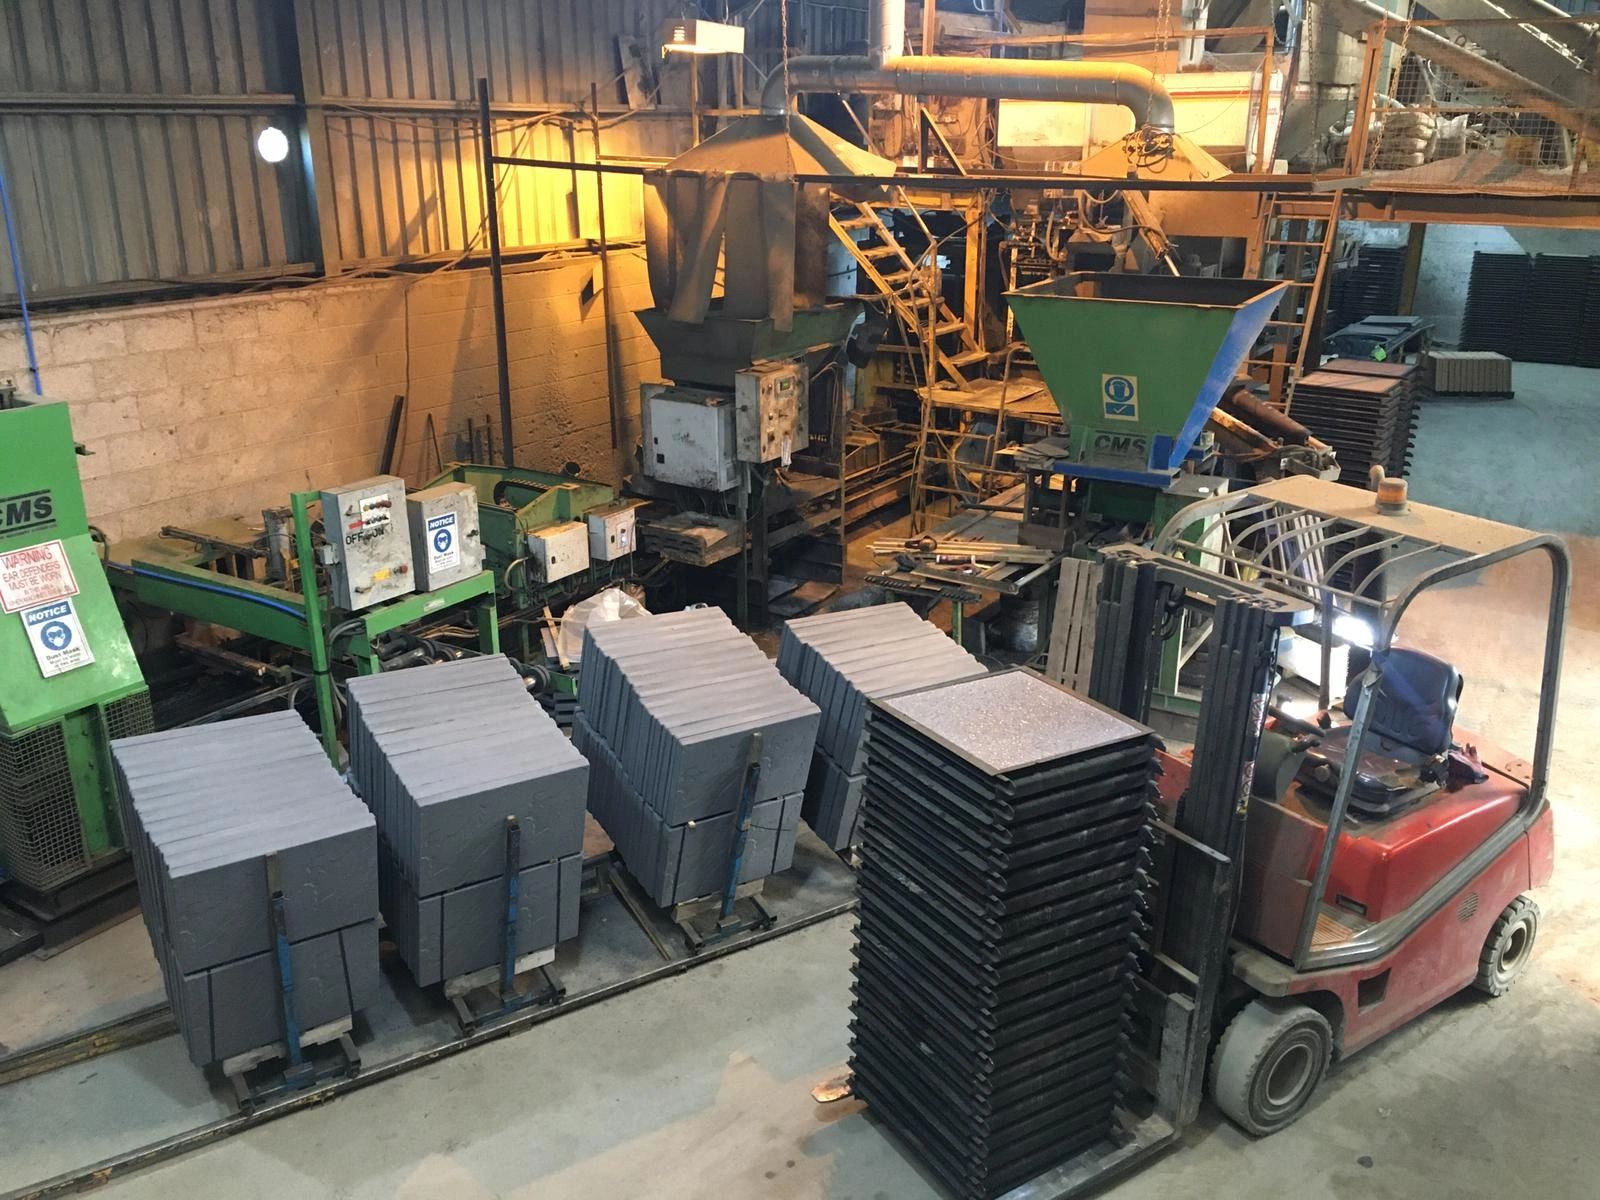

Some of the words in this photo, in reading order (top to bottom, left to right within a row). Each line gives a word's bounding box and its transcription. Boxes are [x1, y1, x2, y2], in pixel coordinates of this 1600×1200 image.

[1095, 435, 1147, 456] CMS
[0, 496, 53, 527] MS
[429, 516, 454, 529] NOTICE
[1, 546, 53, 570] WARNING
[2, 570, 19, 583] EAR
[19, 560, 61, 578] DEFENDERS
[8, 578, 29, 591] MUST
[29, 575, 40, 586] BE
[39, 571, 62, 583] WORN
[28, 604, 68, 623] NOTICE
